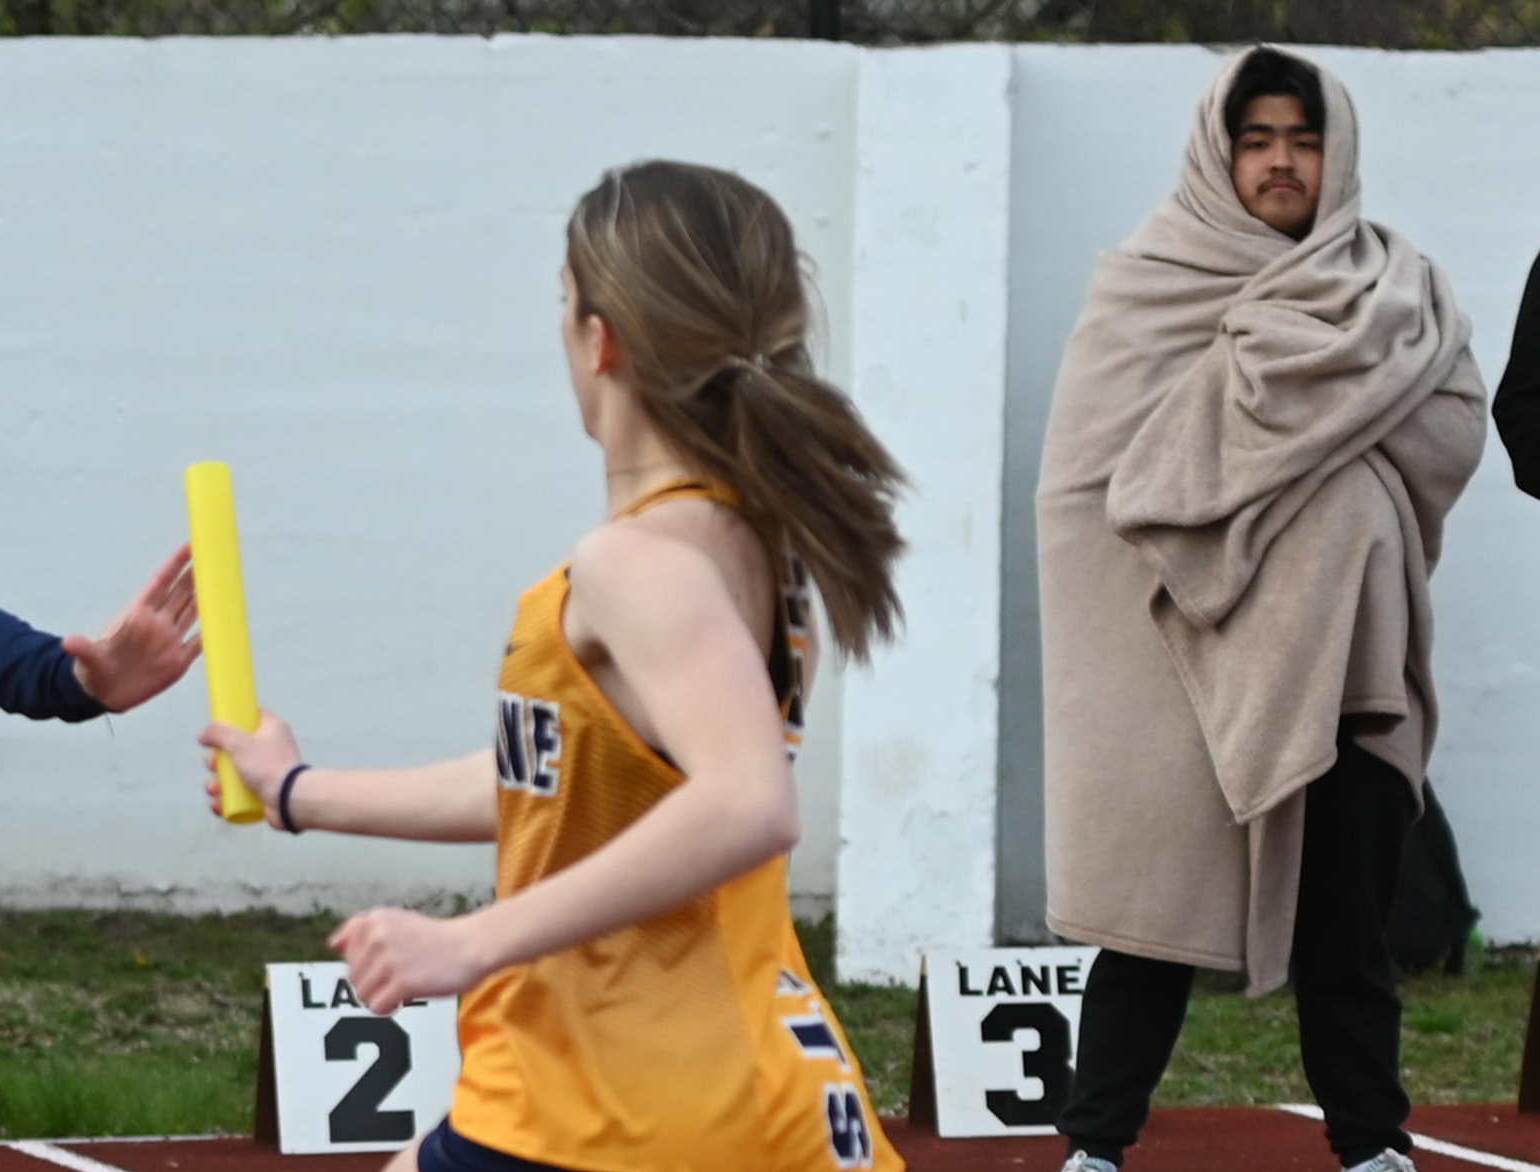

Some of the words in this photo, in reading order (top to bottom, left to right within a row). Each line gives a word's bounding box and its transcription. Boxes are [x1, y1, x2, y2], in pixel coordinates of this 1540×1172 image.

[301, 977, 429, 1009] LA
[958, 964, 1085, 996] LANE
[324, 1016, 416, 1143] 2
[980, 1002, 1075, 1127] 3
